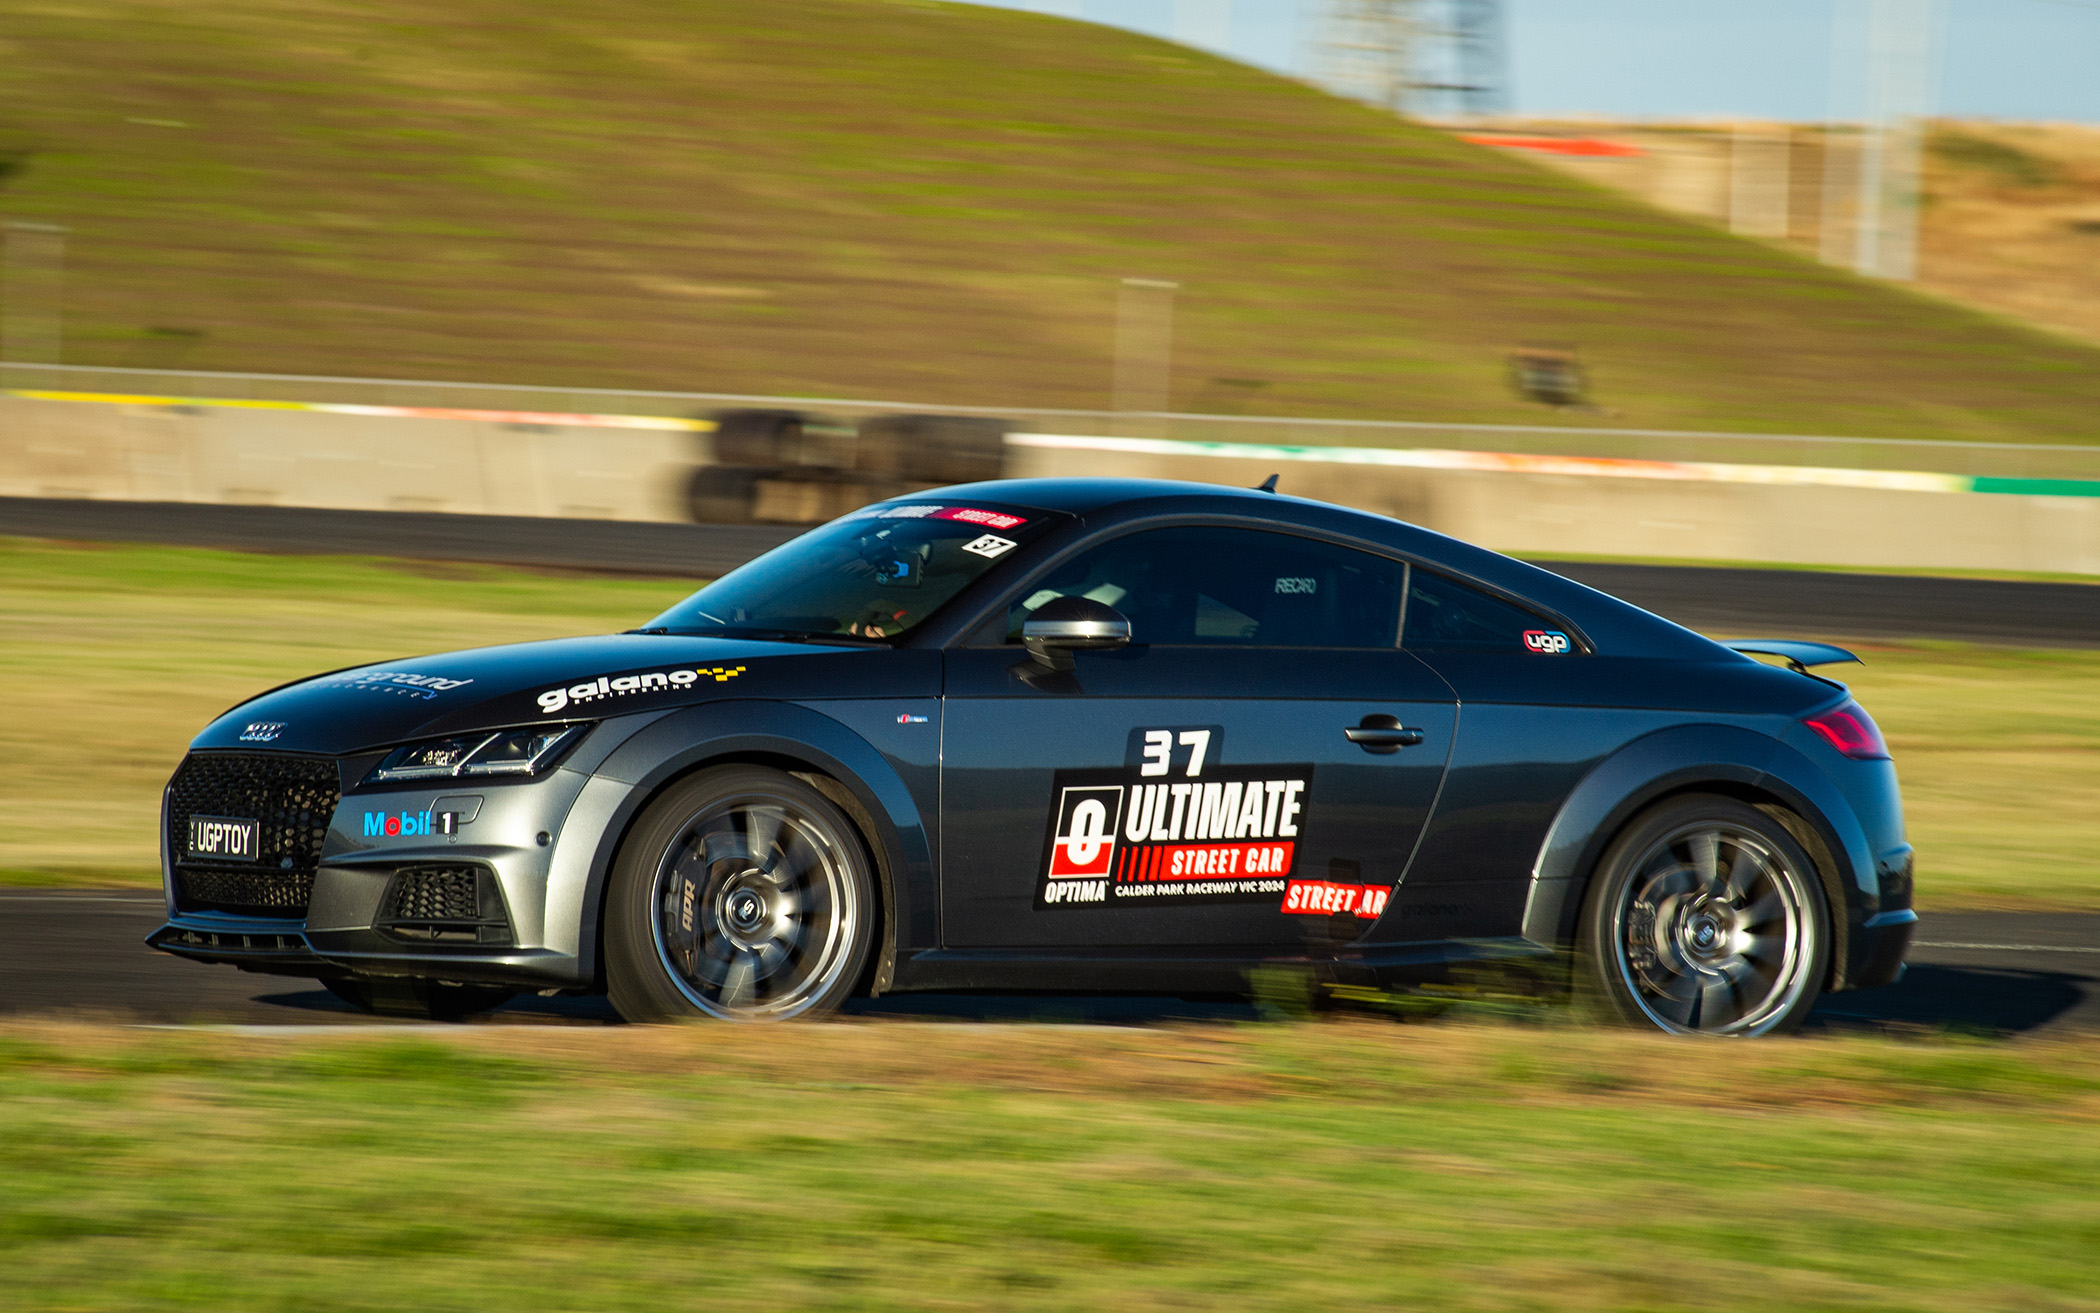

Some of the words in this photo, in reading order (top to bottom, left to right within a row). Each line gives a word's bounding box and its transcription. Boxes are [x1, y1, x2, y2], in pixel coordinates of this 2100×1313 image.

[972, 538, 1008, 554] 37
[537, 670, 698, 713] galano
[1140, 729, 1211, 777] 37
[363, 811, 432, 837] Mobil
[442, 812, 452, 834] 1
[1125, 780, 1305, 842] ULTIMATE
[197, 821, 251, 855] UGPTOY
[1170, 848, 1240, 876] STREET
[1245, 847, 1285, 873] CAR
[1044, 880, 1106, 904] OPTIMA
[1114, 885, 1155, 897] CALDER
[1156, 884, 1185, 896] PARK
[1186, 882, 1238, 895] RACEWAY
[1238, 881, 1257, 893] VIC
[1258, 880, 1285, 892] 2024
[1287, 884, 1356, 913] STREET
[1355, 889, 1388, 915] AR
[682, 879, 696, 932] APR
